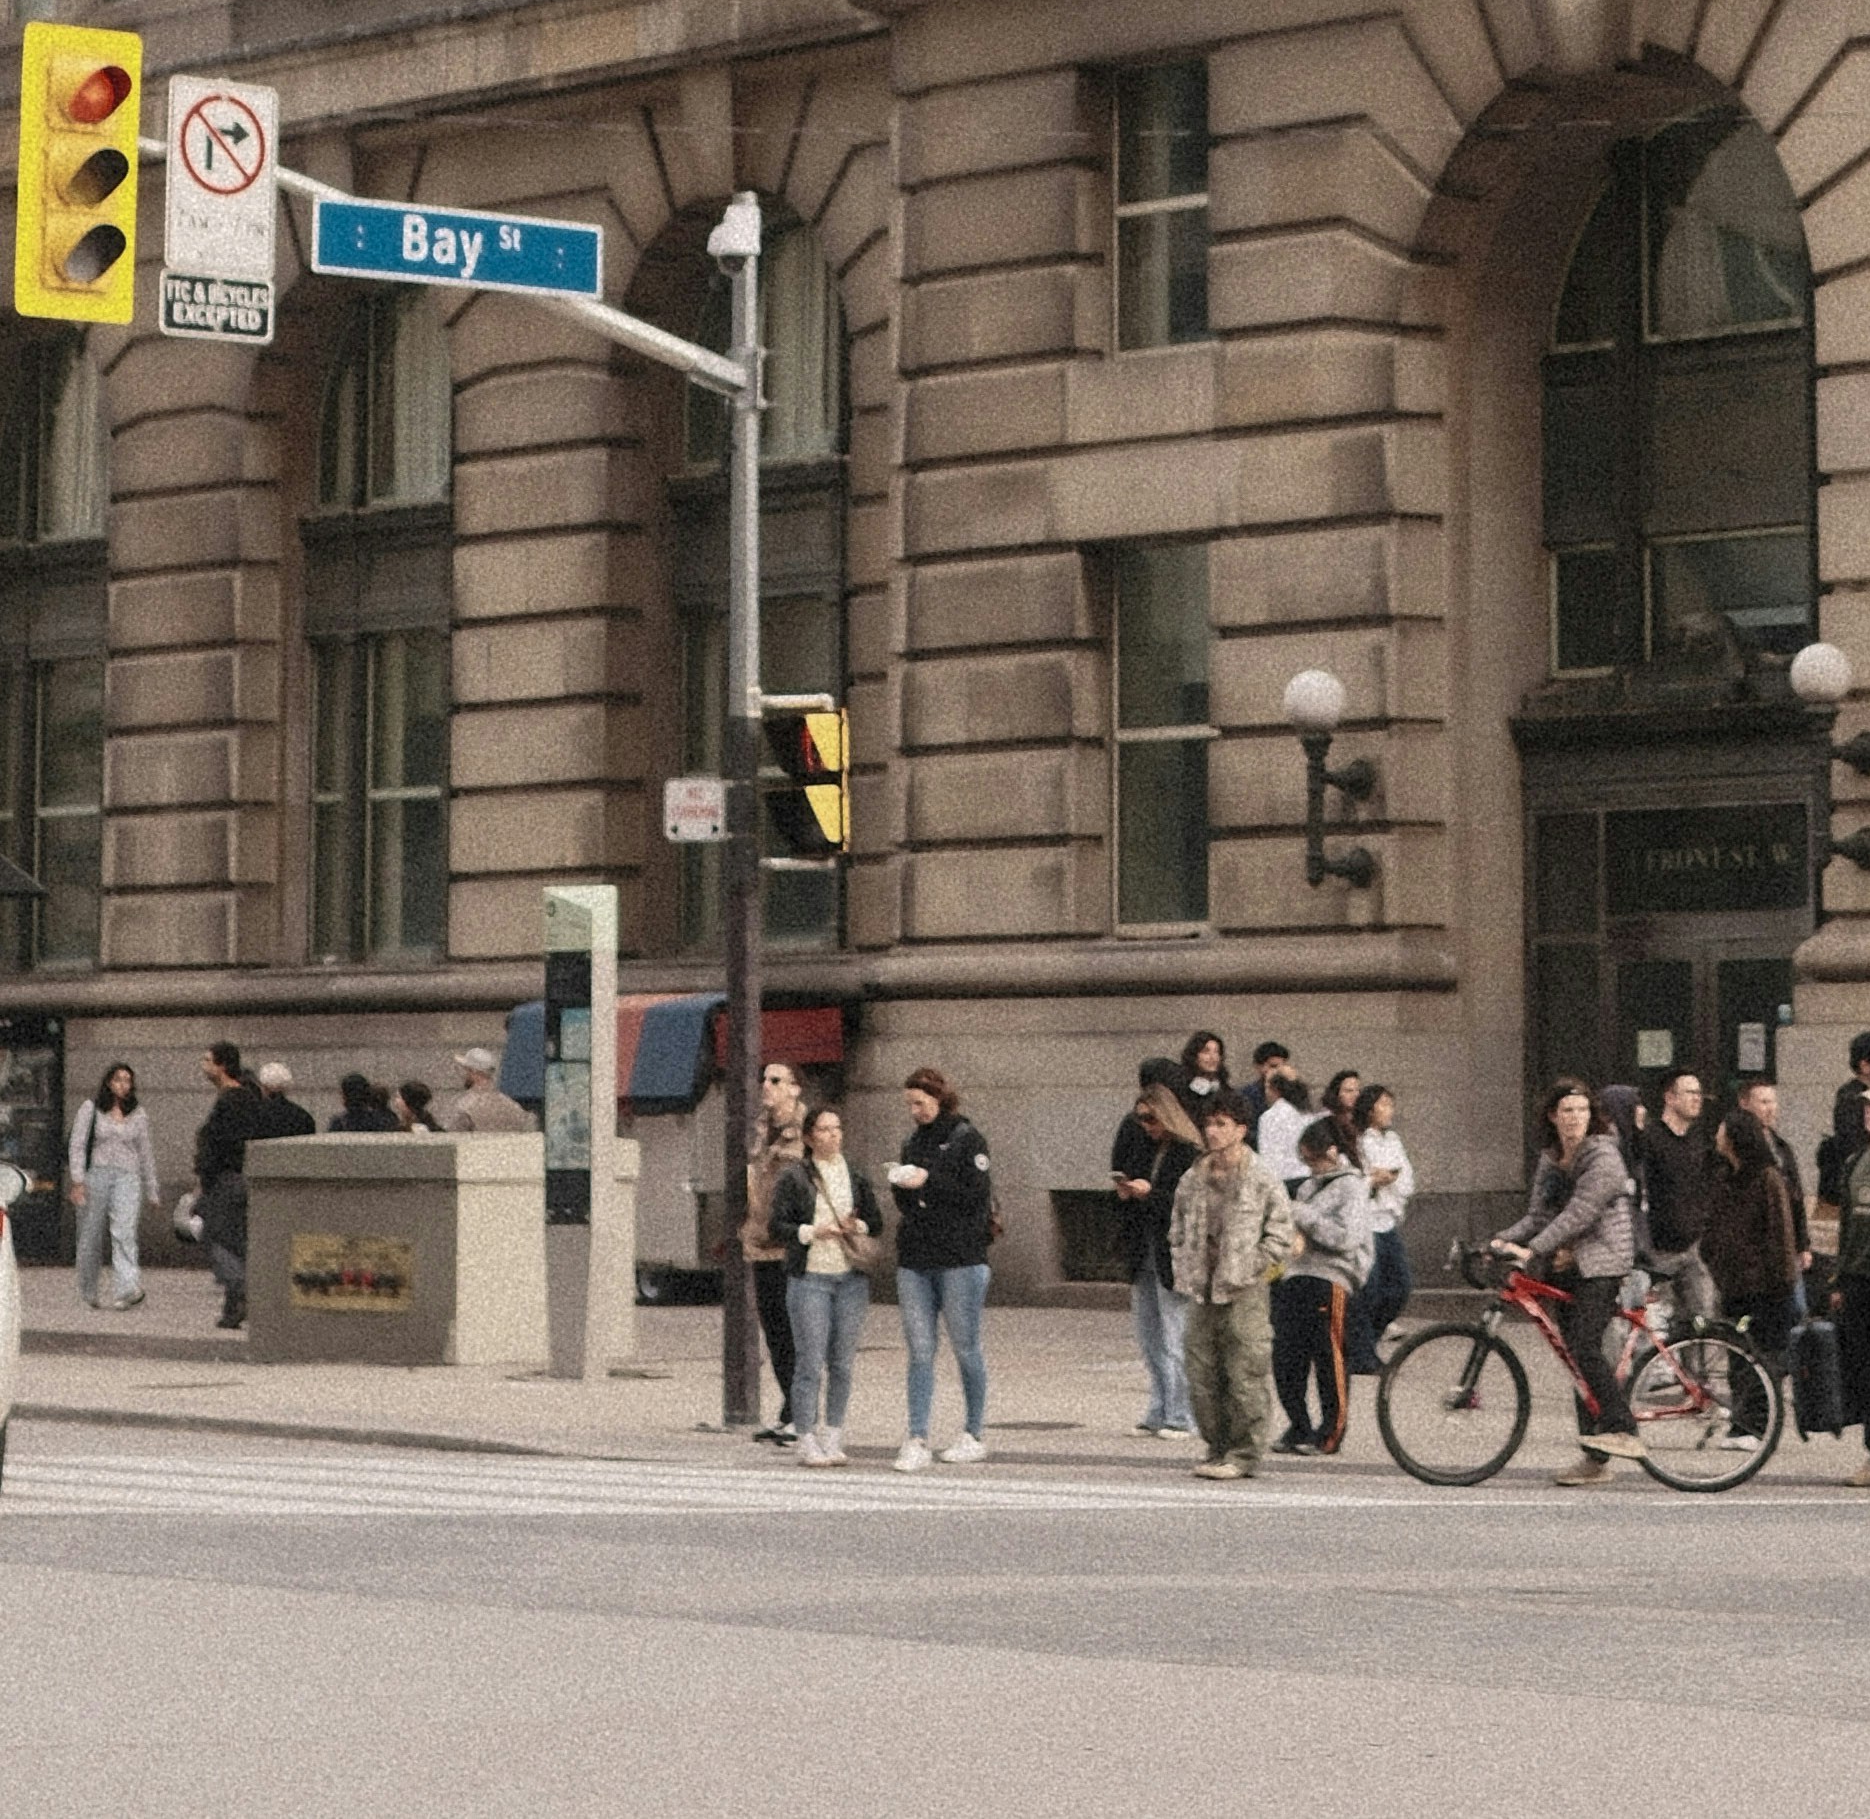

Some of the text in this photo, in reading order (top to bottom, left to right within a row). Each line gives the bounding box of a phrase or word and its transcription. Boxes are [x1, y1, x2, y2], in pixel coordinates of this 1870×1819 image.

[402, 213, 522, 278] Bay St
[172, 302, 262, 331] EXCEPTED
